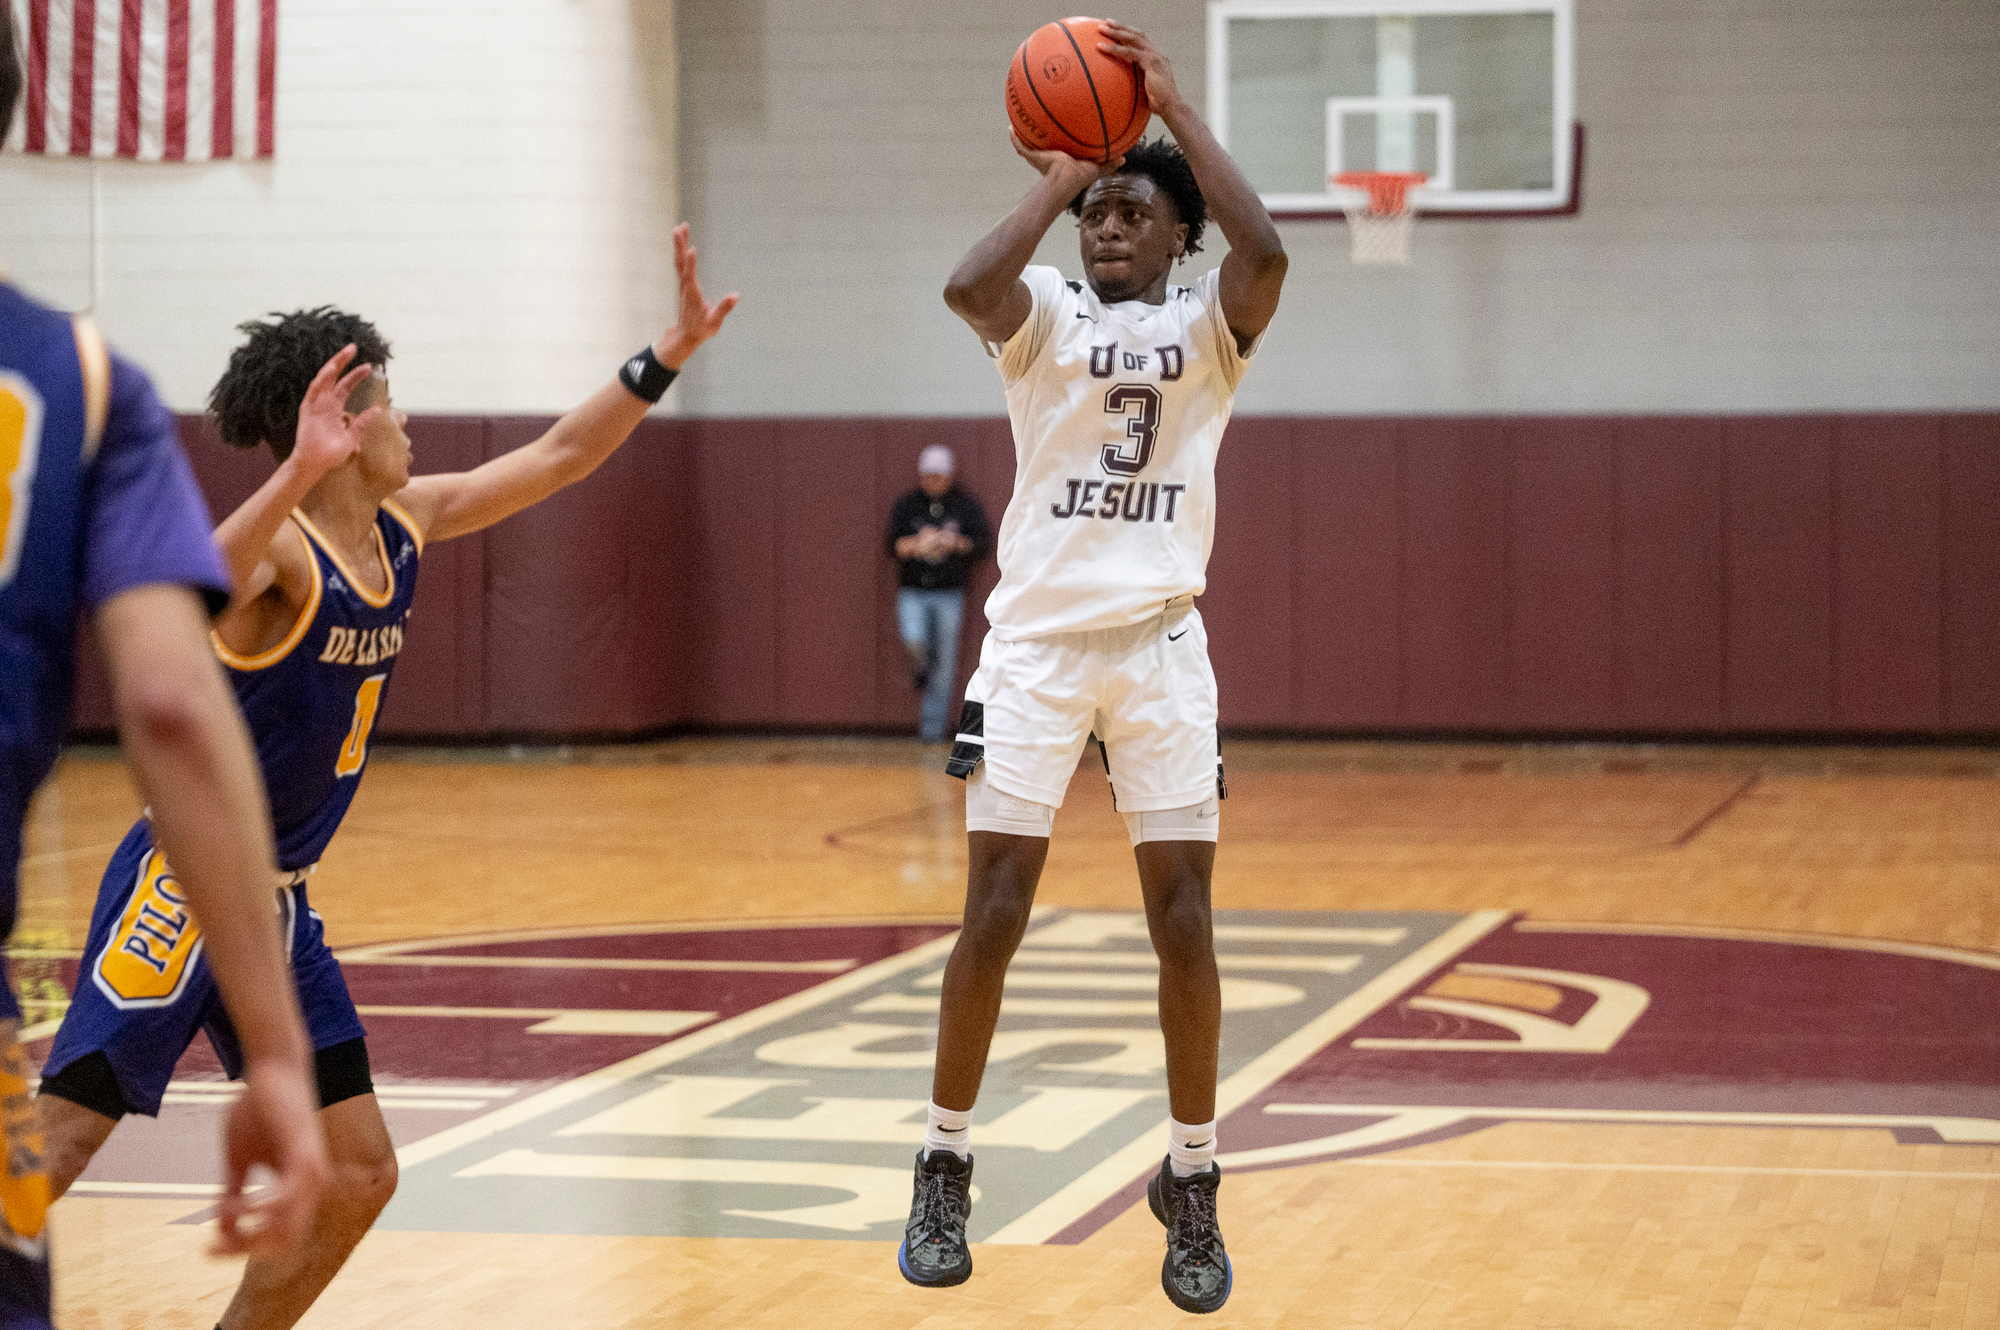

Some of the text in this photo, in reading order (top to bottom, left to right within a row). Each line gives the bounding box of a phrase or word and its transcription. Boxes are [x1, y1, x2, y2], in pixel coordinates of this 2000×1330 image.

[1089, 341, 1185, 382] U OF D
[1100, 383, 1163, 478] 3
[1050, 478, 1187, 523] JESUIT
[335, 673, 387, 779] 0
[121, 872, 190, 976] PILO
